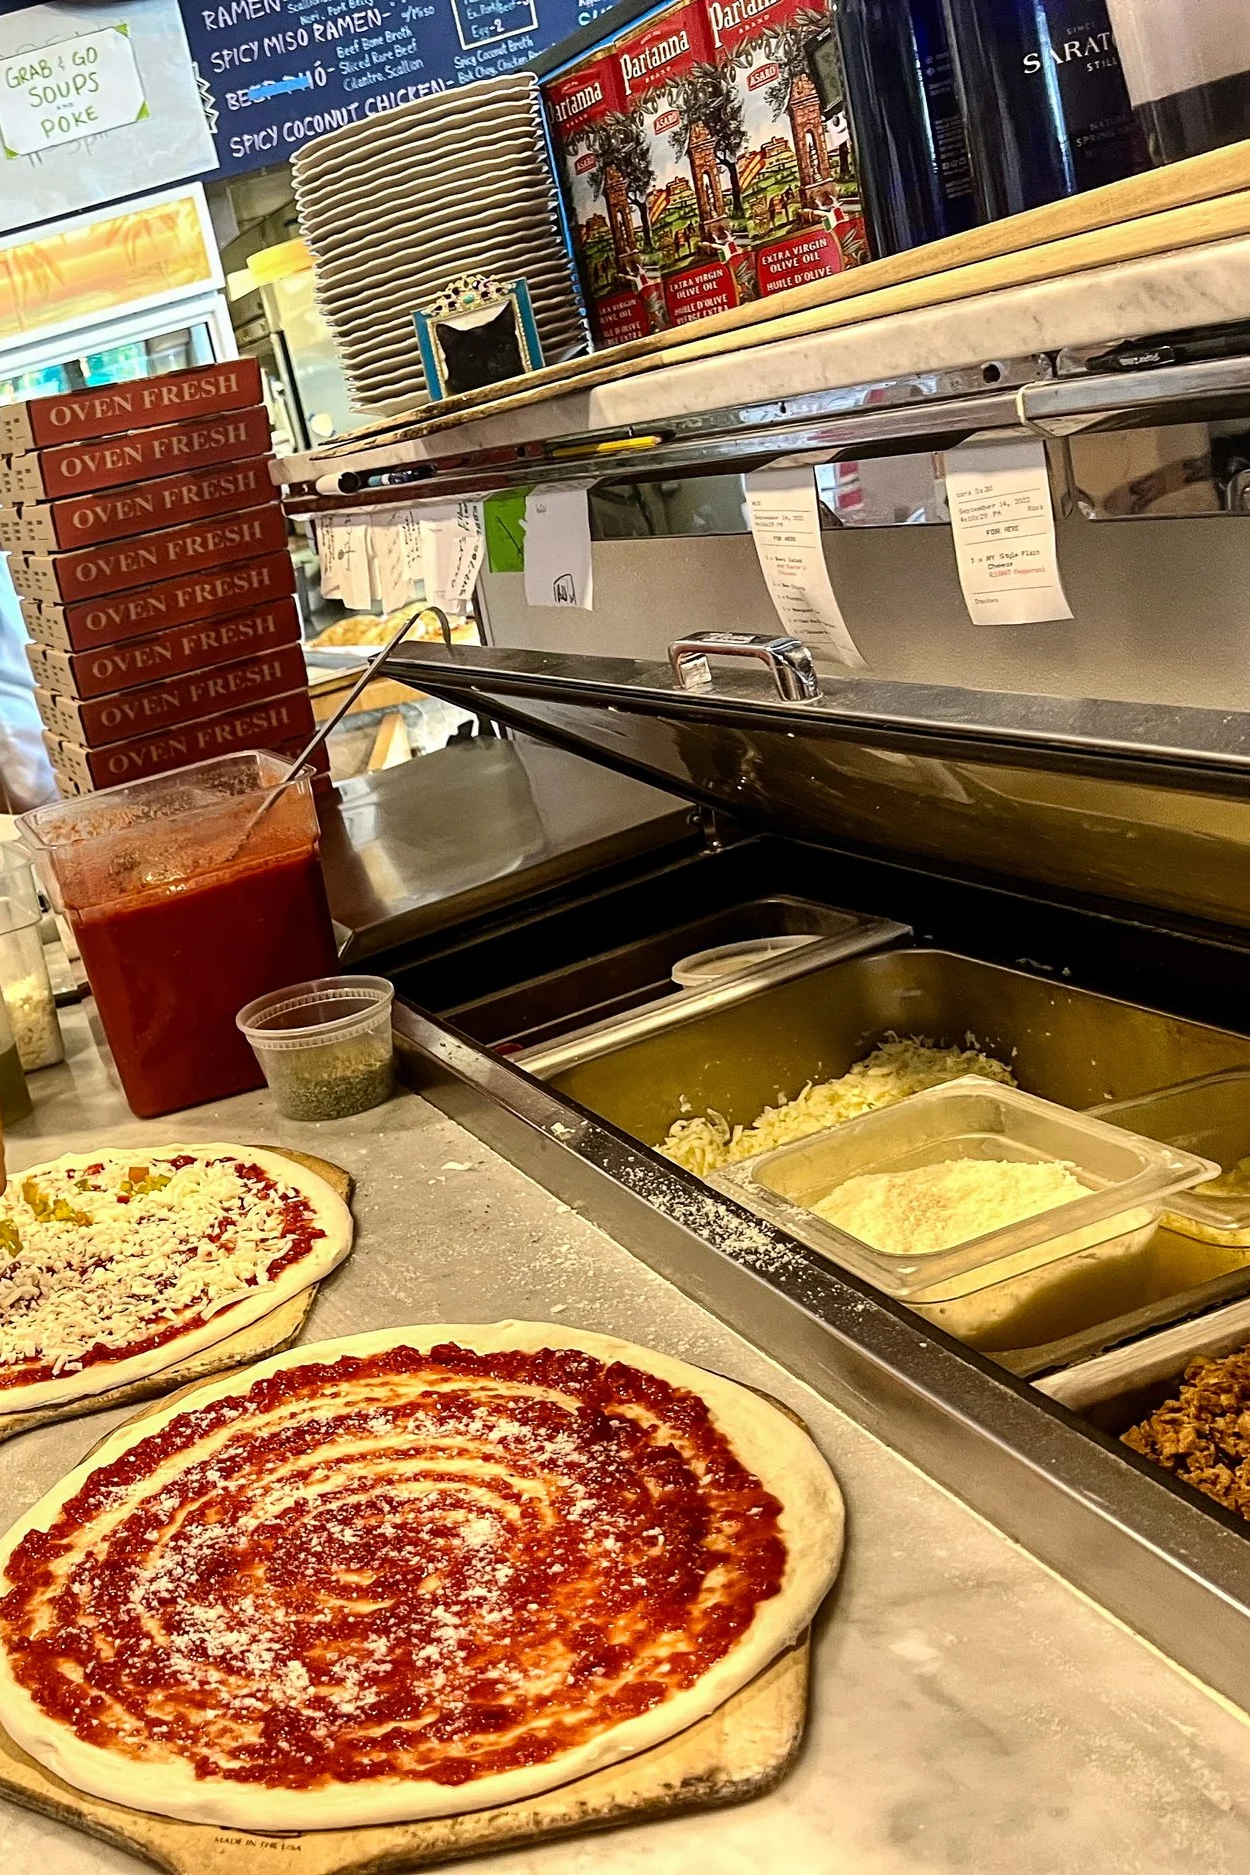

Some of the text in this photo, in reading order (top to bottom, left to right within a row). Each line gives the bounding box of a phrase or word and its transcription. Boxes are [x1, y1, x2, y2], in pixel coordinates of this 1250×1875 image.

[211, 41, 259, 73] SPICY
[263, 28, 309, 57] MISO
[336, 39, 360, 59] Beef
[384, 25, 413, 43] Broth
[338, 53, 371, 75] Sliced
[394, 38, 417, 58] Beef
[1022, 31, 1115, 74] SARAT
[5, 59, 53, 88] GRAB
[72, 46, 98, 66] GO
[620, 30, 690, 96] Partanna
[1086, 56, 1118, 72] STILL
[28, 72, 99, 108] SOUPS
[40, 105, 98, 138] POKE
[230, 126, 279, 157] SPICY
[283, 101, 359, 142] COCONUT
[761, 238, 828, 265] EXTRA VIRGIN
[770, 251, 821, 273] OLIVE OIL
[676, 280, 718, 300] OLIVE OIL
[694, 268, 723, 284] VIRGIN
[766, 265, 833, 291] HUILE D'OLIVE
[696, 293, 728, 310] D'OLIVE
[49, 372, 240, 427] OVEN FRESH
[60, 421, 249, 479] OVEN FRESH
[72, 470, 258, 530] OVEN FRESH
[958, 503, 996, 515] September
[985, 524, 1020, 536] FOR HERE
[75, 521, 264, 583] OVEN FRESH
[985, 554, 996, 562] NY
[999, 551, 1019, 560] Style
[85, 567, 272, 632] OVEN FRESH
[91, 614, 277, 679] OVEN FRESH
[100, 661, 284, 728] OVEN FRESH
[107, 706, 290, 775] OVEN FRESH
[245, 1839, 257, 1847] IN
